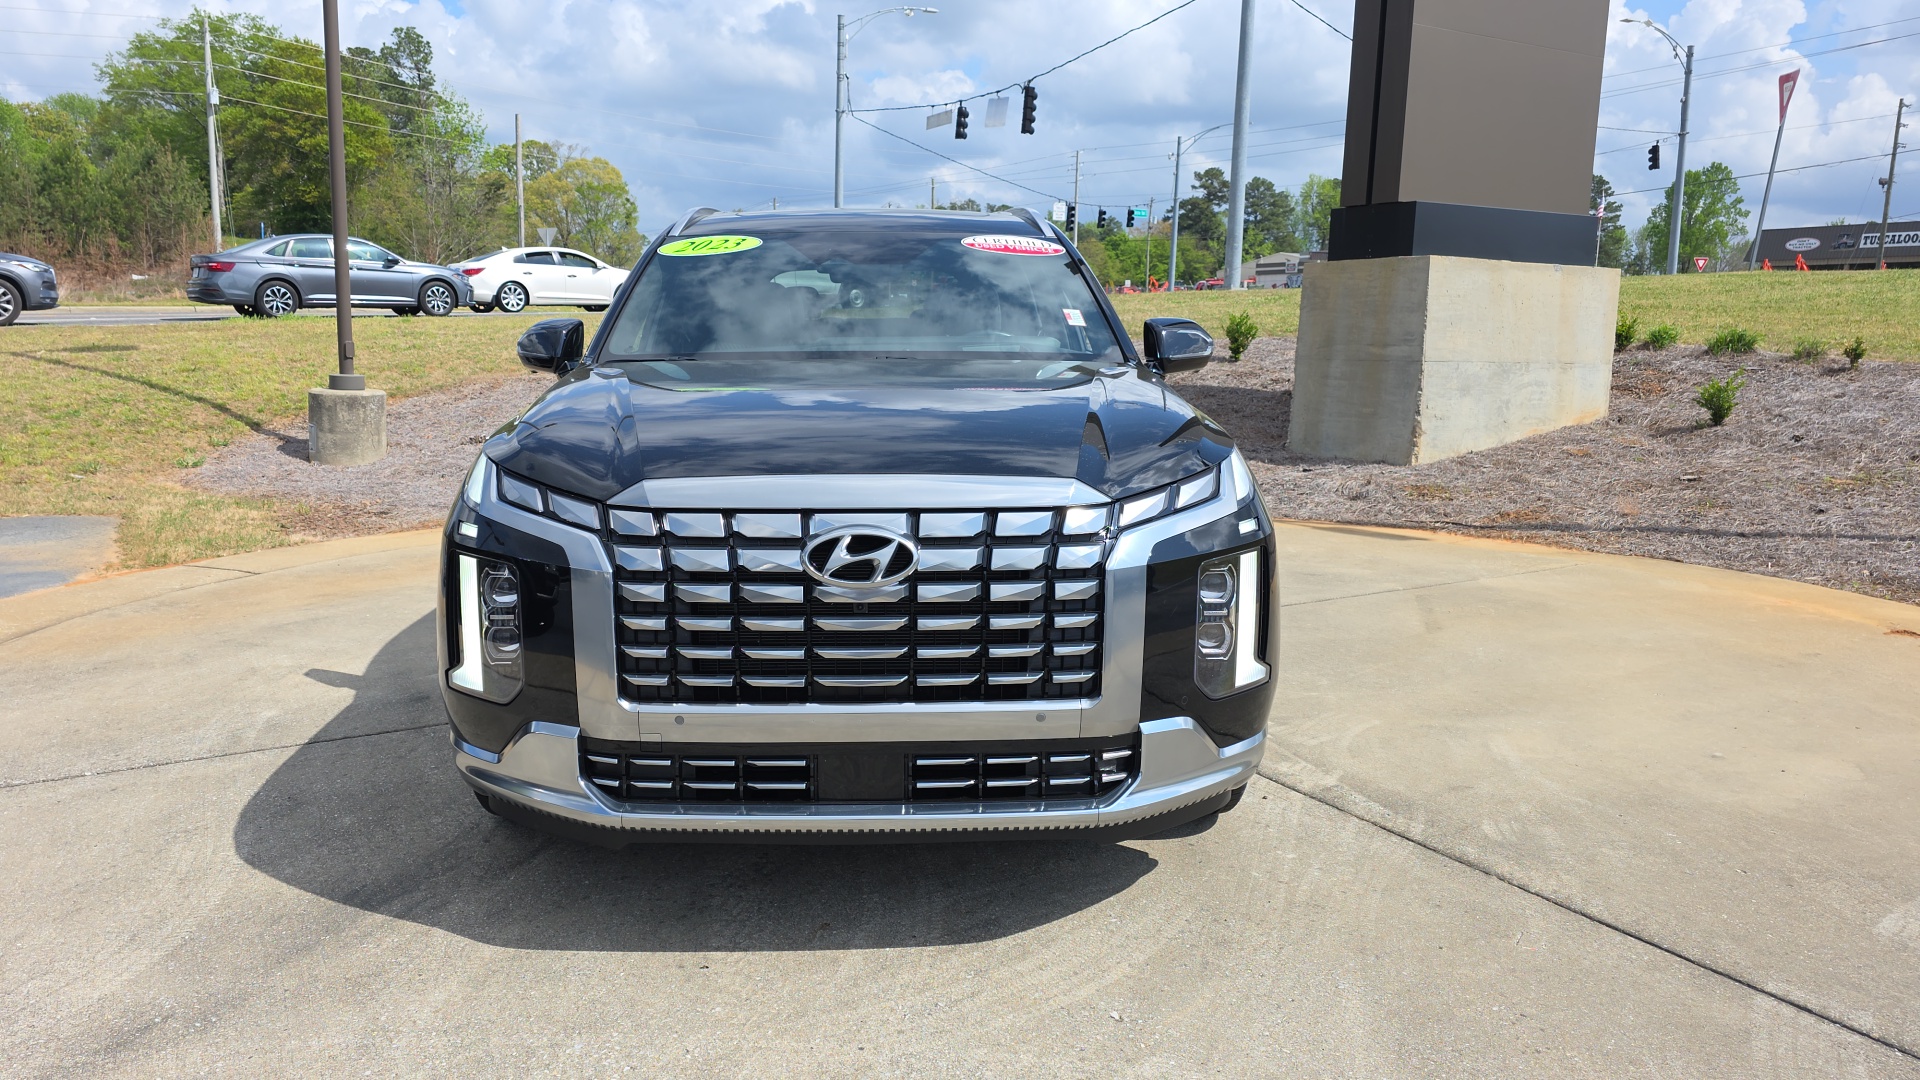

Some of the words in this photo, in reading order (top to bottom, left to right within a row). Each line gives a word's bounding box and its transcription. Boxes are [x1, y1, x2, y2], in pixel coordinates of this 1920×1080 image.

[1863, 233, 1920, 245] TUCALOO
[673, 238, 747, 253] 2023
[1007, 245, 1055, 254] VEHICLE
